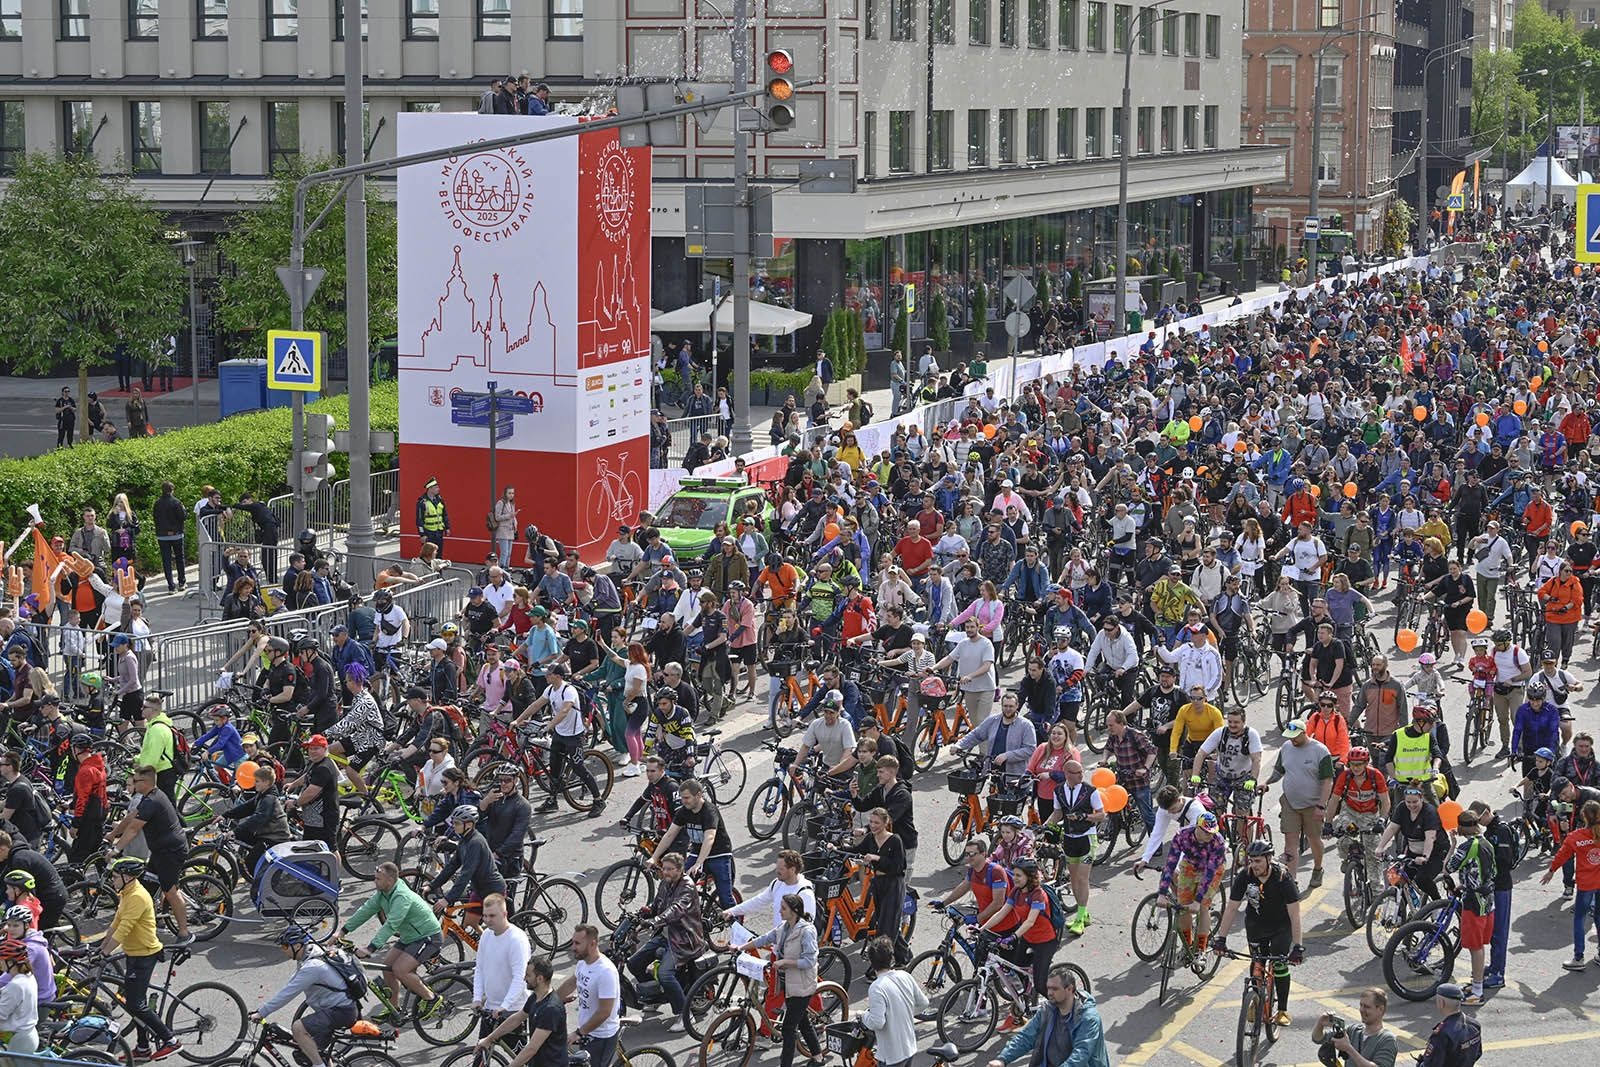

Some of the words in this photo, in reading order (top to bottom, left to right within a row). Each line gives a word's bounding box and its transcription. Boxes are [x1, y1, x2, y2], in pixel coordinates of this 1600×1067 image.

[439, 190, 534, 242] ВЕЛОФЕСТИВАЛЬ
[477, 212, 498, 221] 2025
[595, 191, 635, 242] ВЕЛОФЕСТИВАЛЬ
[611, 213, 620, 221] 2025
